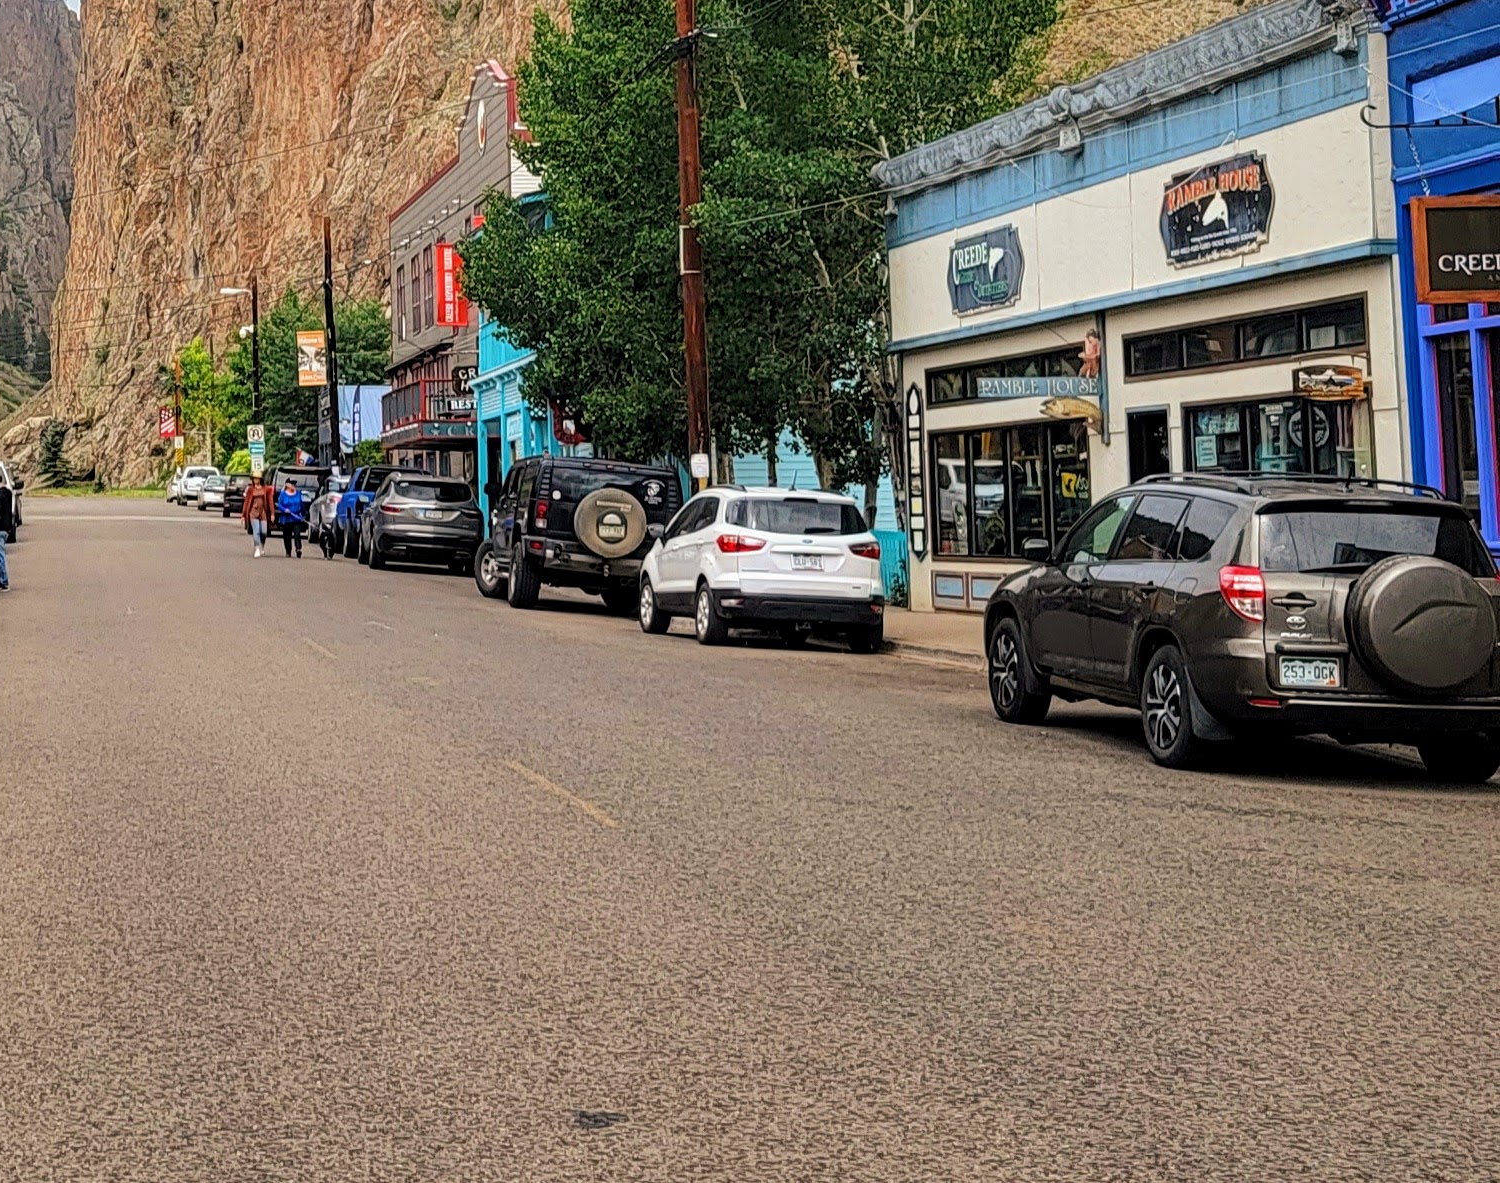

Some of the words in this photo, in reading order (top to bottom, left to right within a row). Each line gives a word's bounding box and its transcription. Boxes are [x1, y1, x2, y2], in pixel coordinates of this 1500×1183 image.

[1167, 177, 1217, 215] RAMBLE
[1218, 164, 1261, 193] HOUSE
[952, 242, 988, 285] CREEDE
[981, 379, 1039, 394] RAMBLE
[1046, 378, 1098, 394] HOUSE
